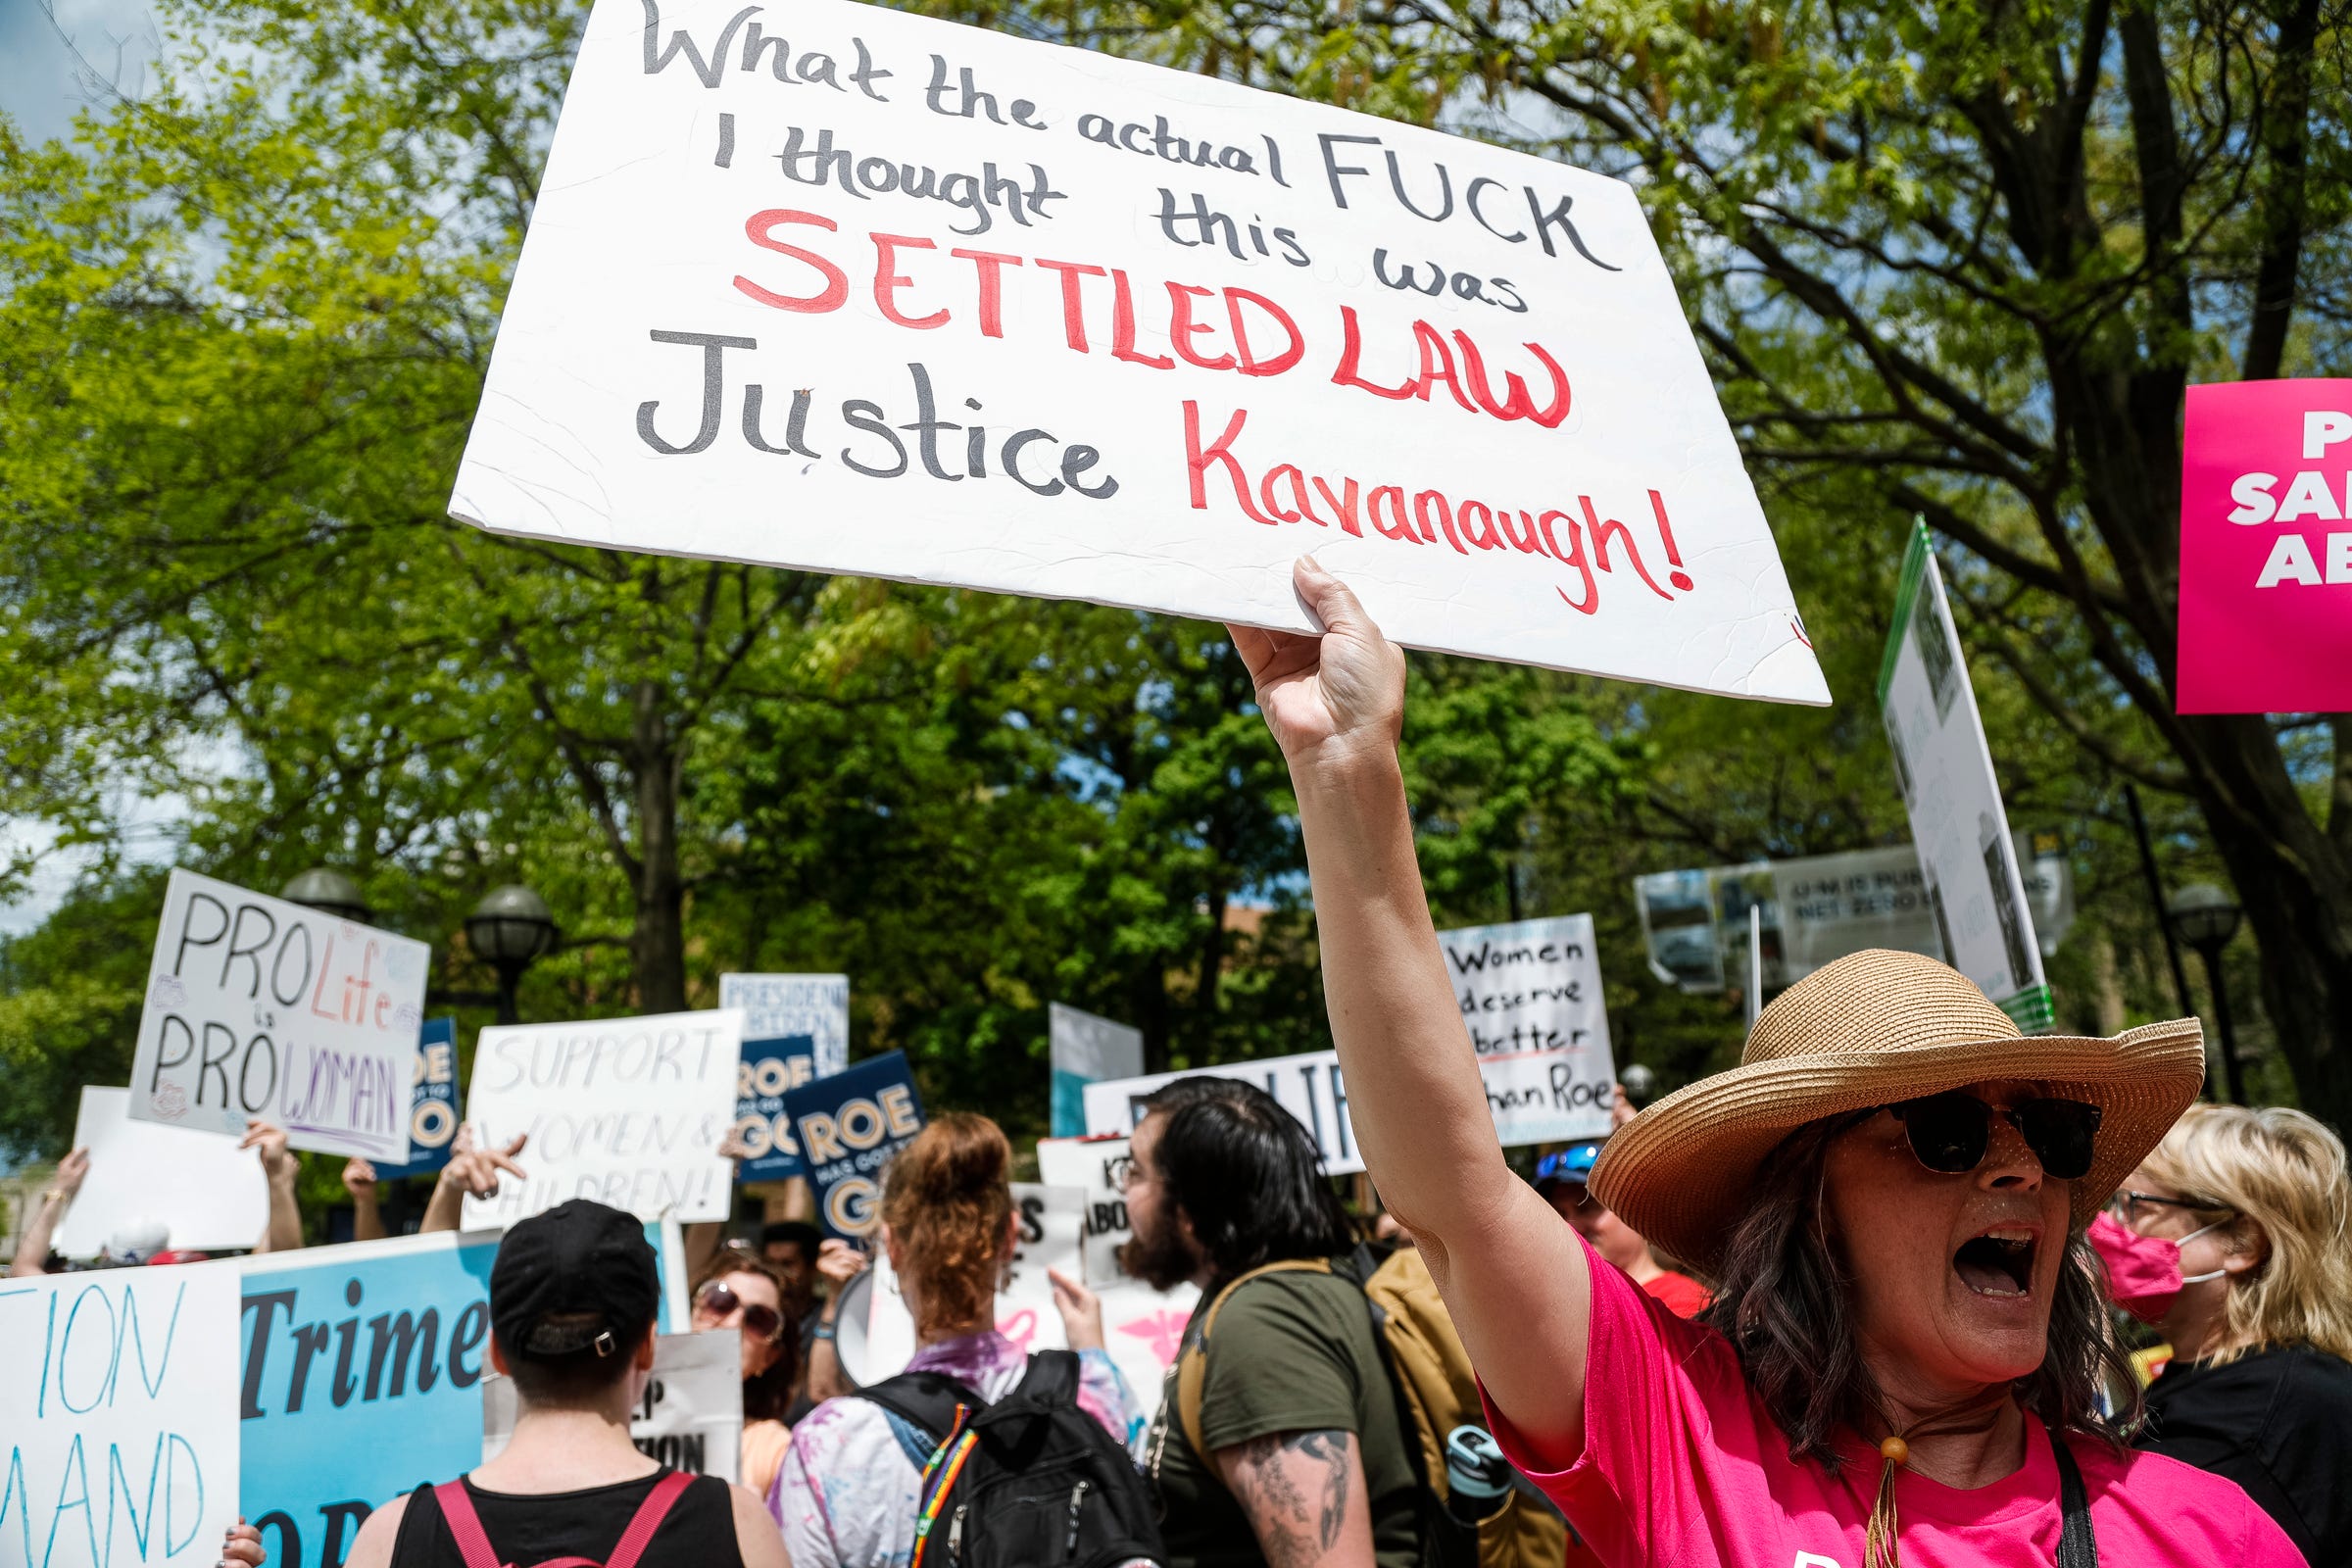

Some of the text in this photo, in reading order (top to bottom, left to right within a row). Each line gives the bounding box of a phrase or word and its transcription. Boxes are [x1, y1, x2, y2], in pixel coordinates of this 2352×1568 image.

[641, 0, 1623, 271] What the actual FUCK
[714, 113, 1529, 313] I thought this was
[732, 208, 1572, 428] SETTLED LAW
[636, 329, 1694, 614] Justice Kavanaugh!
[2227, 470, 2352, 525] SA
[1448, 942, 1583, 975] Women
[1460, 978, 1583, 1015] deserve
[485, 1027, 723, 1095] SUPPORT
[1473, 1020, 1590, 1054] better
[1484, 1062, 1613, 1114] han Roe
[797, 1082, 921, 1165] ROE
